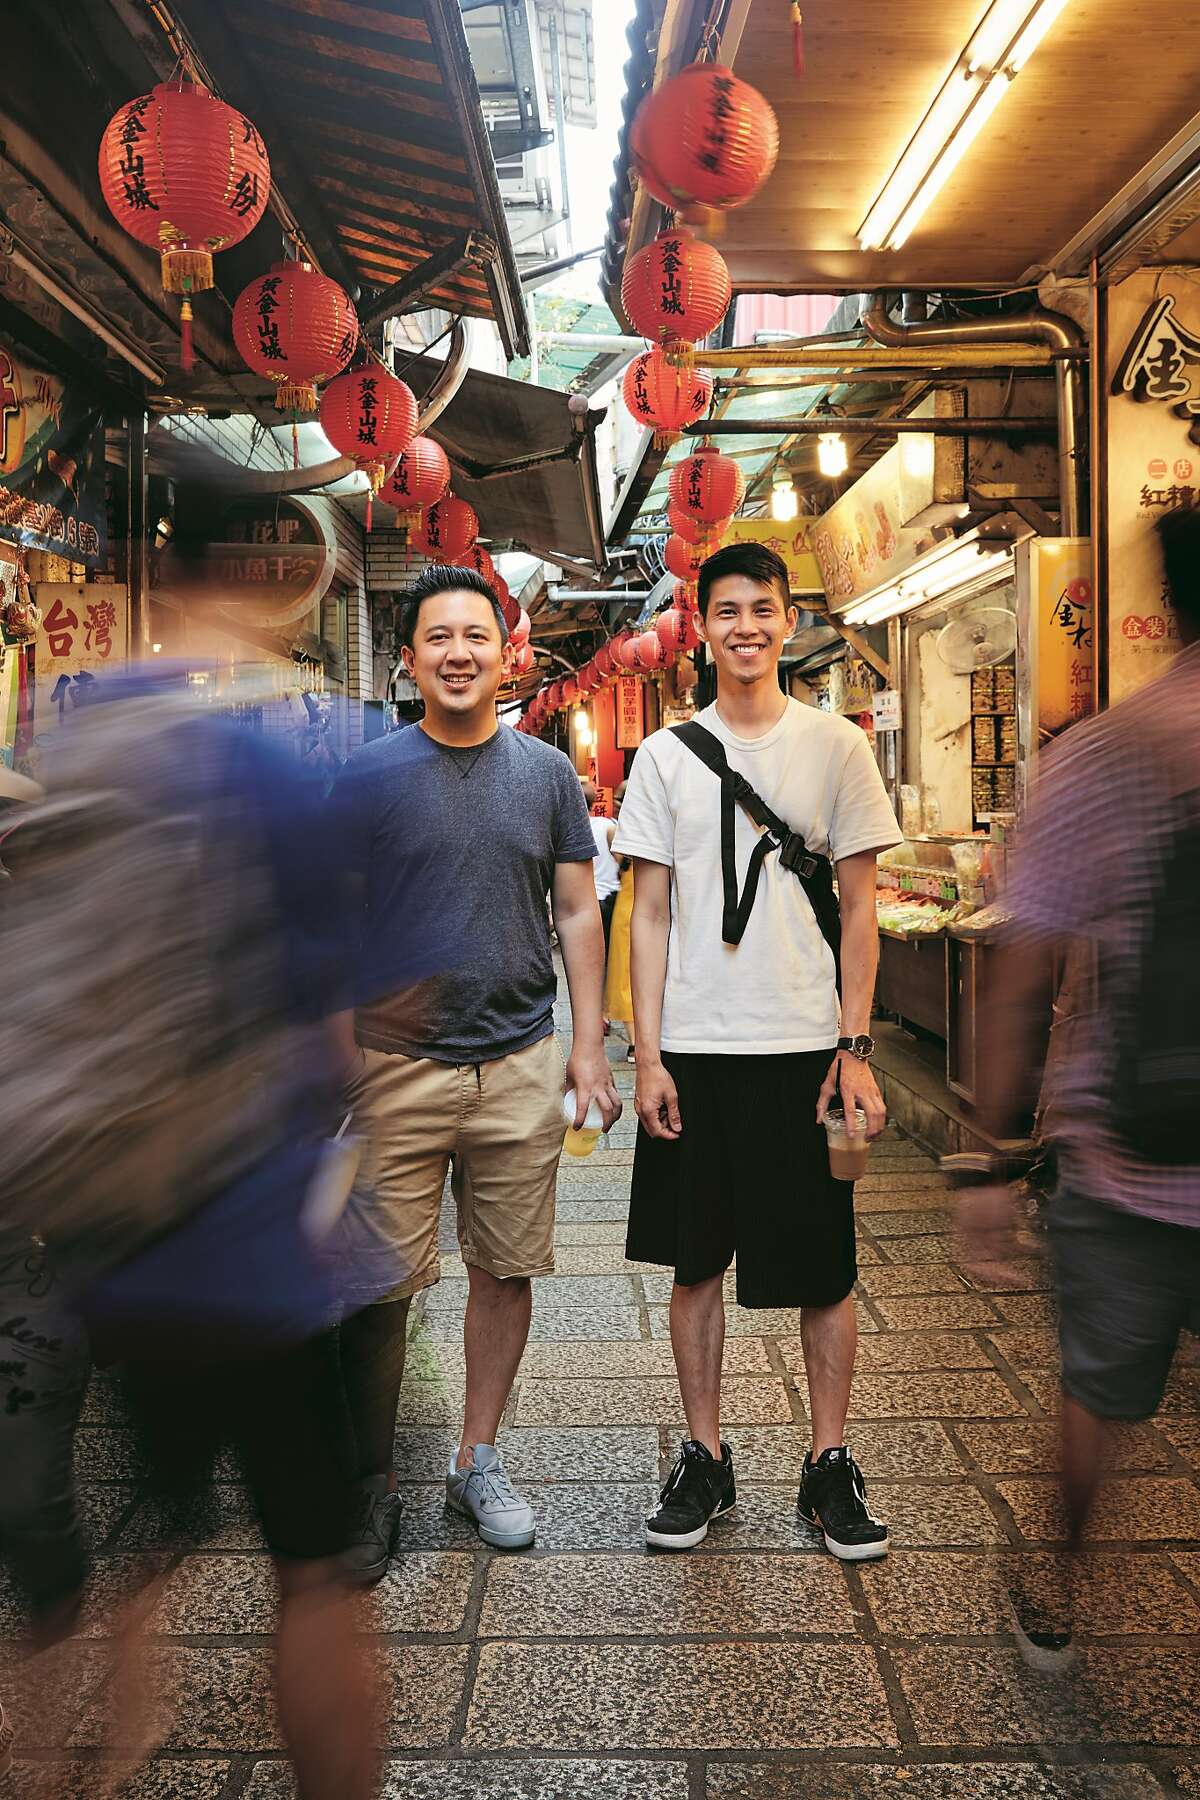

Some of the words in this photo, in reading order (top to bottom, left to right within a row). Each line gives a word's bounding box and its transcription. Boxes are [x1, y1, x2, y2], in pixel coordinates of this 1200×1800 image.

[118, 96, 159, 212] 黃金山城
[660, 240, 685, 316] 黃金山城
[255, 278, 288, 361] 黃金山城
[356, 377, 379, 447] 黃金山城
[632, 354, 656, 416] 黃金山城
[687, 458, 704, 511] 黃金山城
[43, 599, 117, 657] 台灣
[1124, 618, 1163, 637] 盒裝
